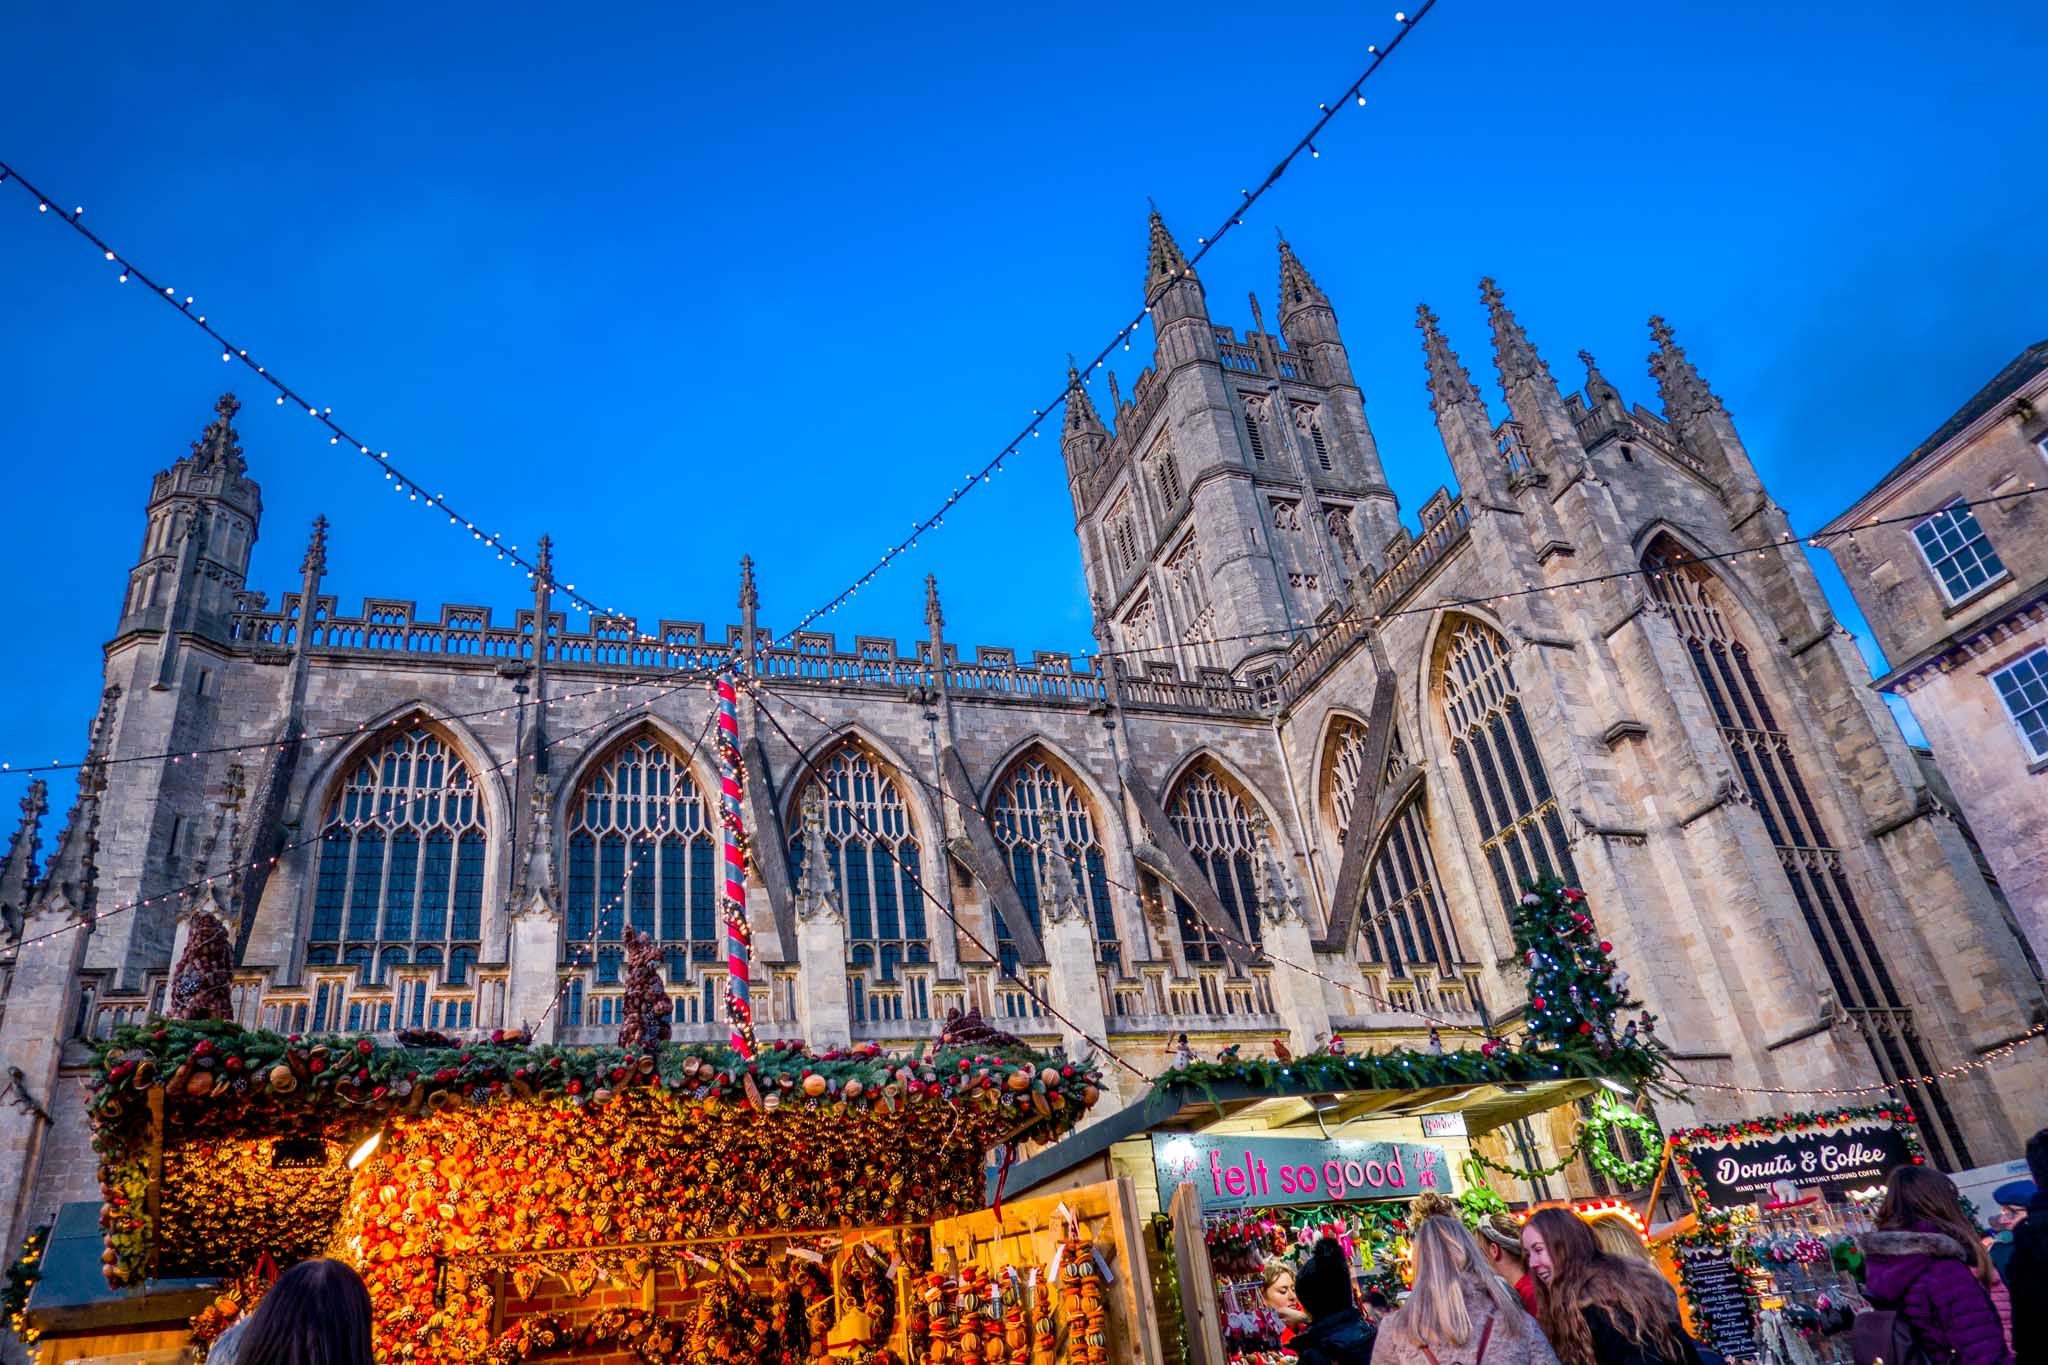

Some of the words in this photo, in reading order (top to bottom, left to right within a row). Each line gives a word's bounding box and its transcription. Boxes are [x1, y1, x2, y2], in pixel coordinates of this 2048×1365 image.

[1210, 1149, 1270, 1196] felt
[1279, 1165, 1318, 1193] so
[1323, 1145, 1406, 1201] good
[1717, 1155, 1796, 1184] Donuts
[1800, 1151, 1817, 1173] &
[1820, 1142, 1886, 1172] Coffee
[1735, 1183, 1754, 1193] HAND
[1754, 1181, 1771, 1190] MAD
[1831, 1171, 1857, 1181] GROUND
[1858, 1168, 1881, 1178] COFFEE
